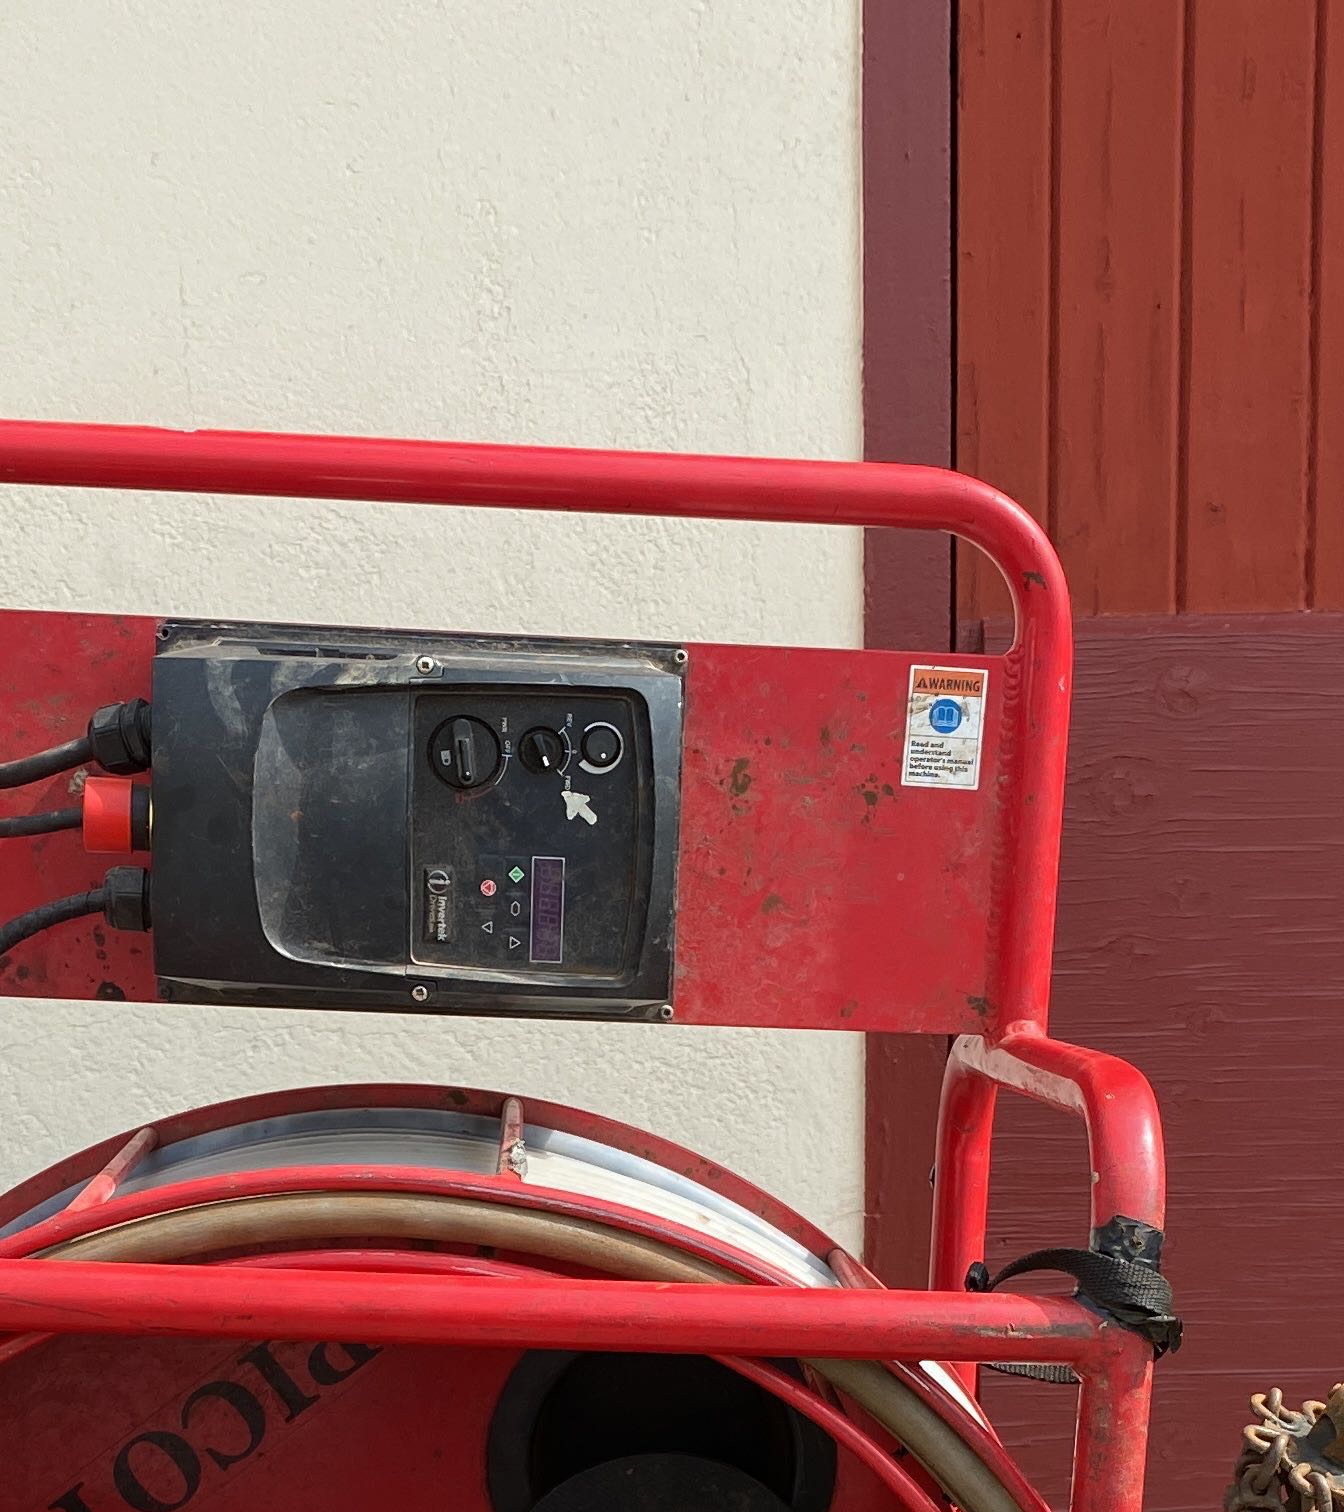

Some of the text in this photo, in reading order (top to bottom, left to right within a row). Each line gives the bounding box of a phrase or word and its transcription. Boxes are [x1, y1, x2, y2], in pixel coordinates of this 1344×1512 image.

[928, 678, 981, 692] WARNING
[911, 740, 929, 748] Read
[437, 896, 448, 941] Invertek
